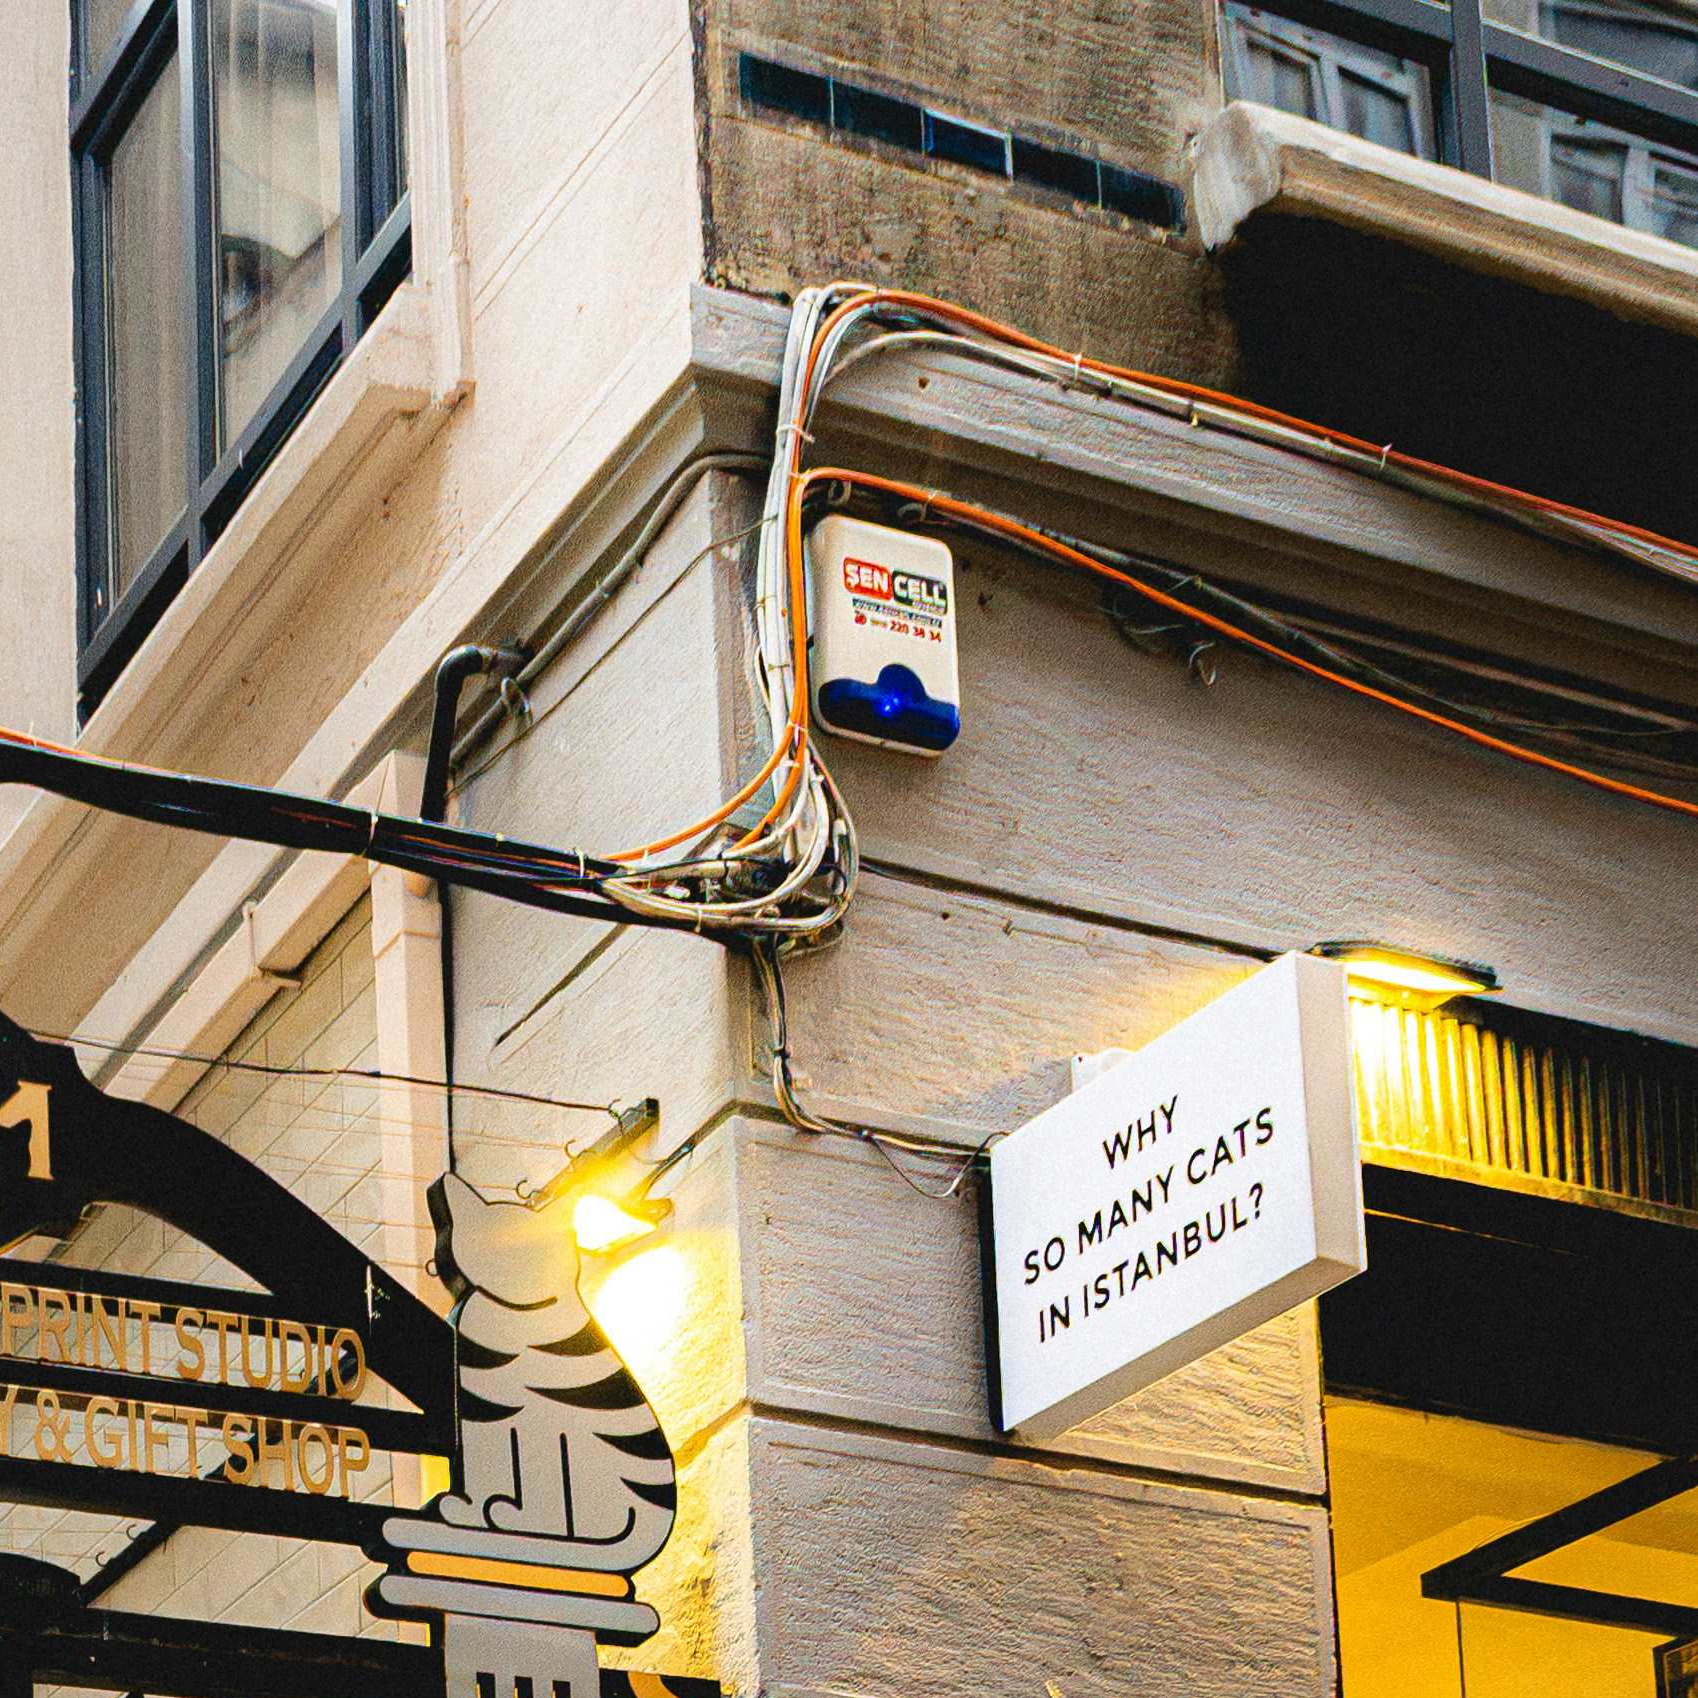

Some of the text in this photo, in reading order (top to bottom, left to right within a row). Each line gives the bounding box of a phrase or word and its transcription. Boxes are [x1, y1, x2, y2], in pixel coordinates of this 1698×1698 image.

[846, 563, 946, 607] ŞEN CELL
[1102, 1094, 1179, 1170] WHY
[1024, 1107, 1274, 1285] SO MANY CATS
[1039, 1183, 1265, 1342] IN ISTANBUL?
[1, 1281, 162, 1373] PRINT
[176, 1309, 367, 1401] STUDIO
[35, 1388, 71, 1461] &
[84, 1395, 207, 1480] GIFT
[224, 1415, 371, 1497] SHOP
